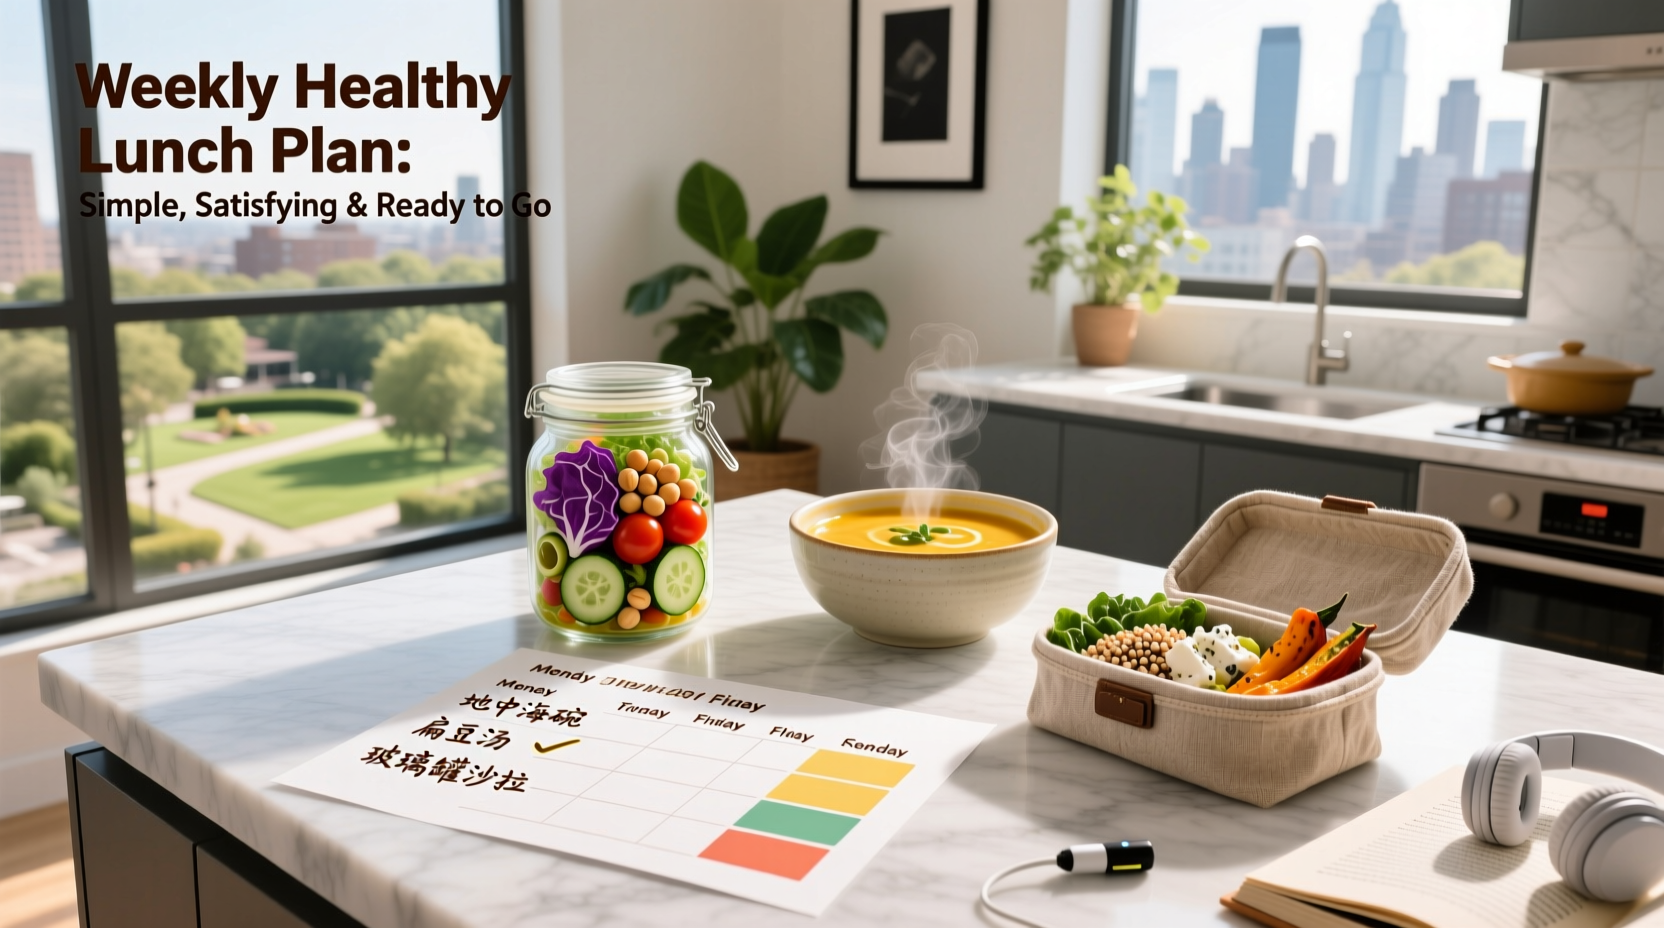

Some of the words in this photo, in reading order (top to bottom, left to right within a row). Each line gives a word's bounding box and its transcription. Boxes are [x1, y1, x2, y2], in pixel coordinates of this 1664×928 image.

[458, 693, 588, 728] 地中海碗
[411, 716, 511, 750] 扁豆汤
[360, 744, 529, 793] 玻璃罐沙拉
